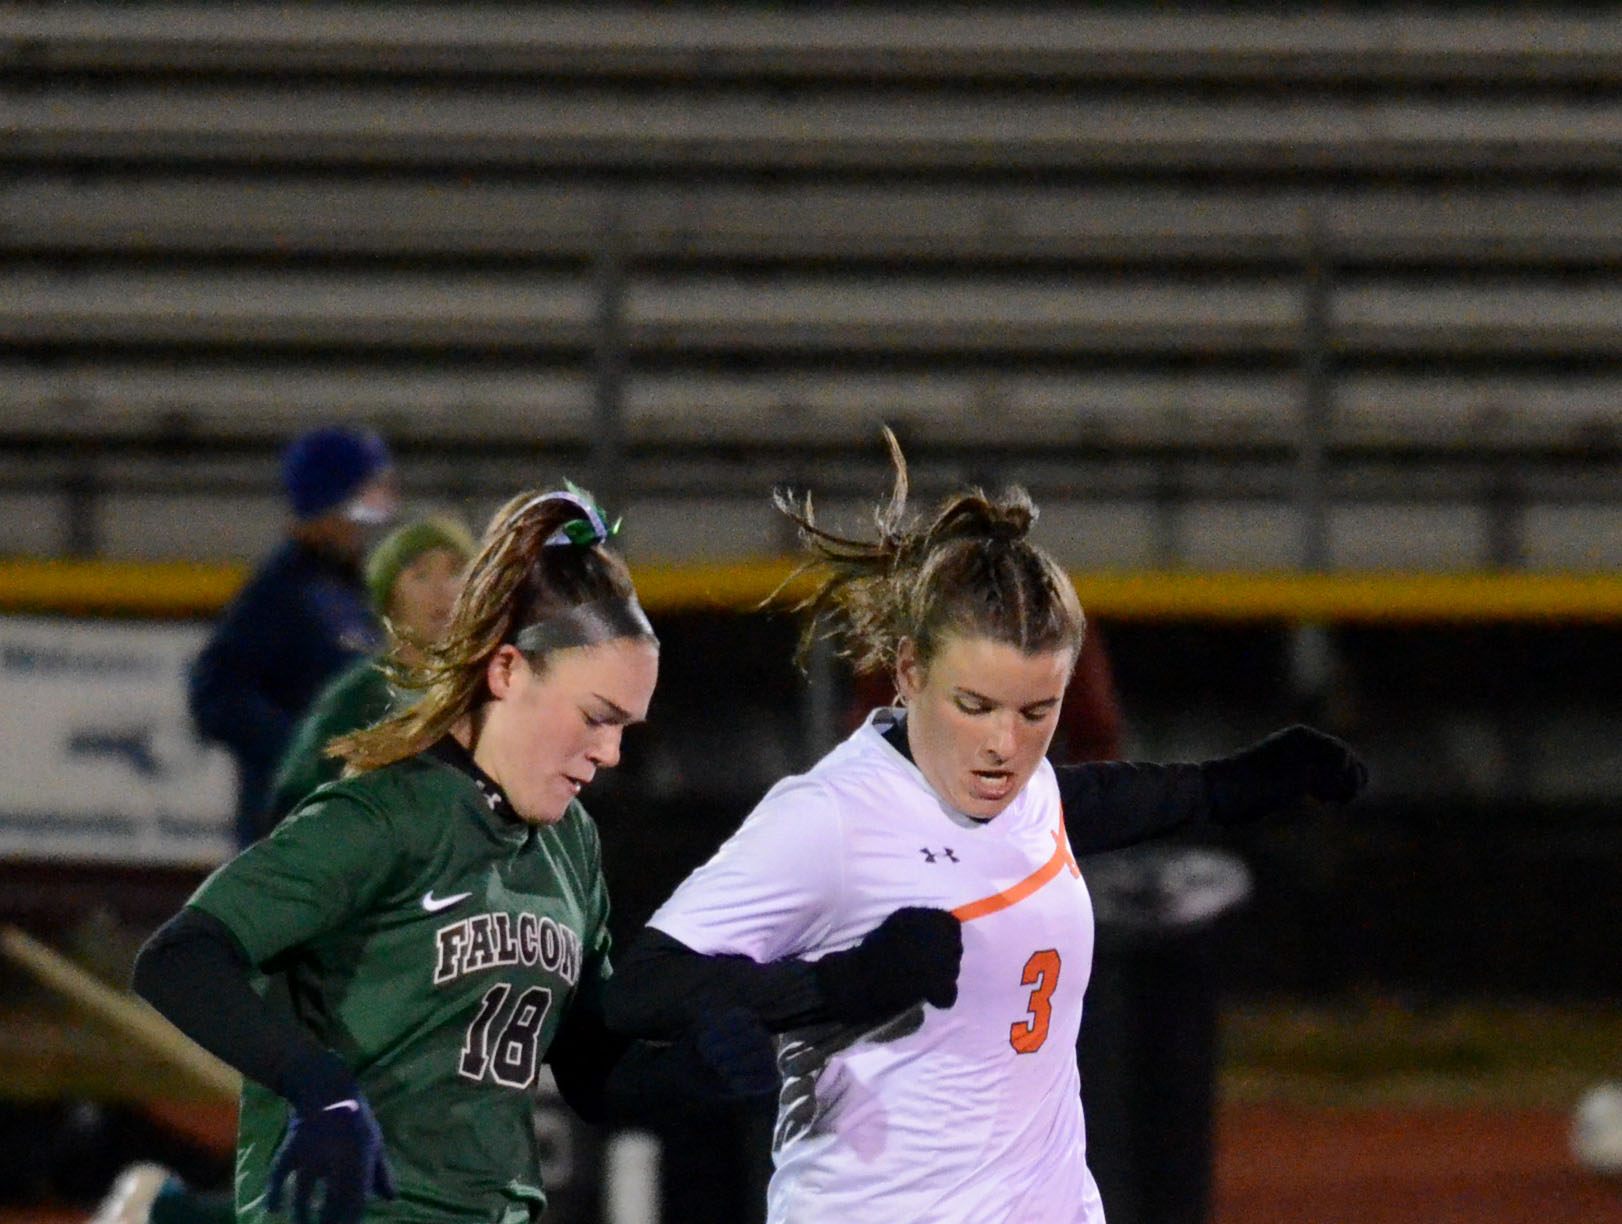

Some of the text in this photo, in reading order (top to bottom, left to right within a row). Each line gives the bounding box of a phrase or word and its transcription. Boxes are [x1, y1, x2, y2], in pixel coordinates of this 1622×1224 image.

[434, 911, 583, 987] FALCON
[1009, 948, 1062, 1055] 3
[458, 982, 552, 1089] 18
